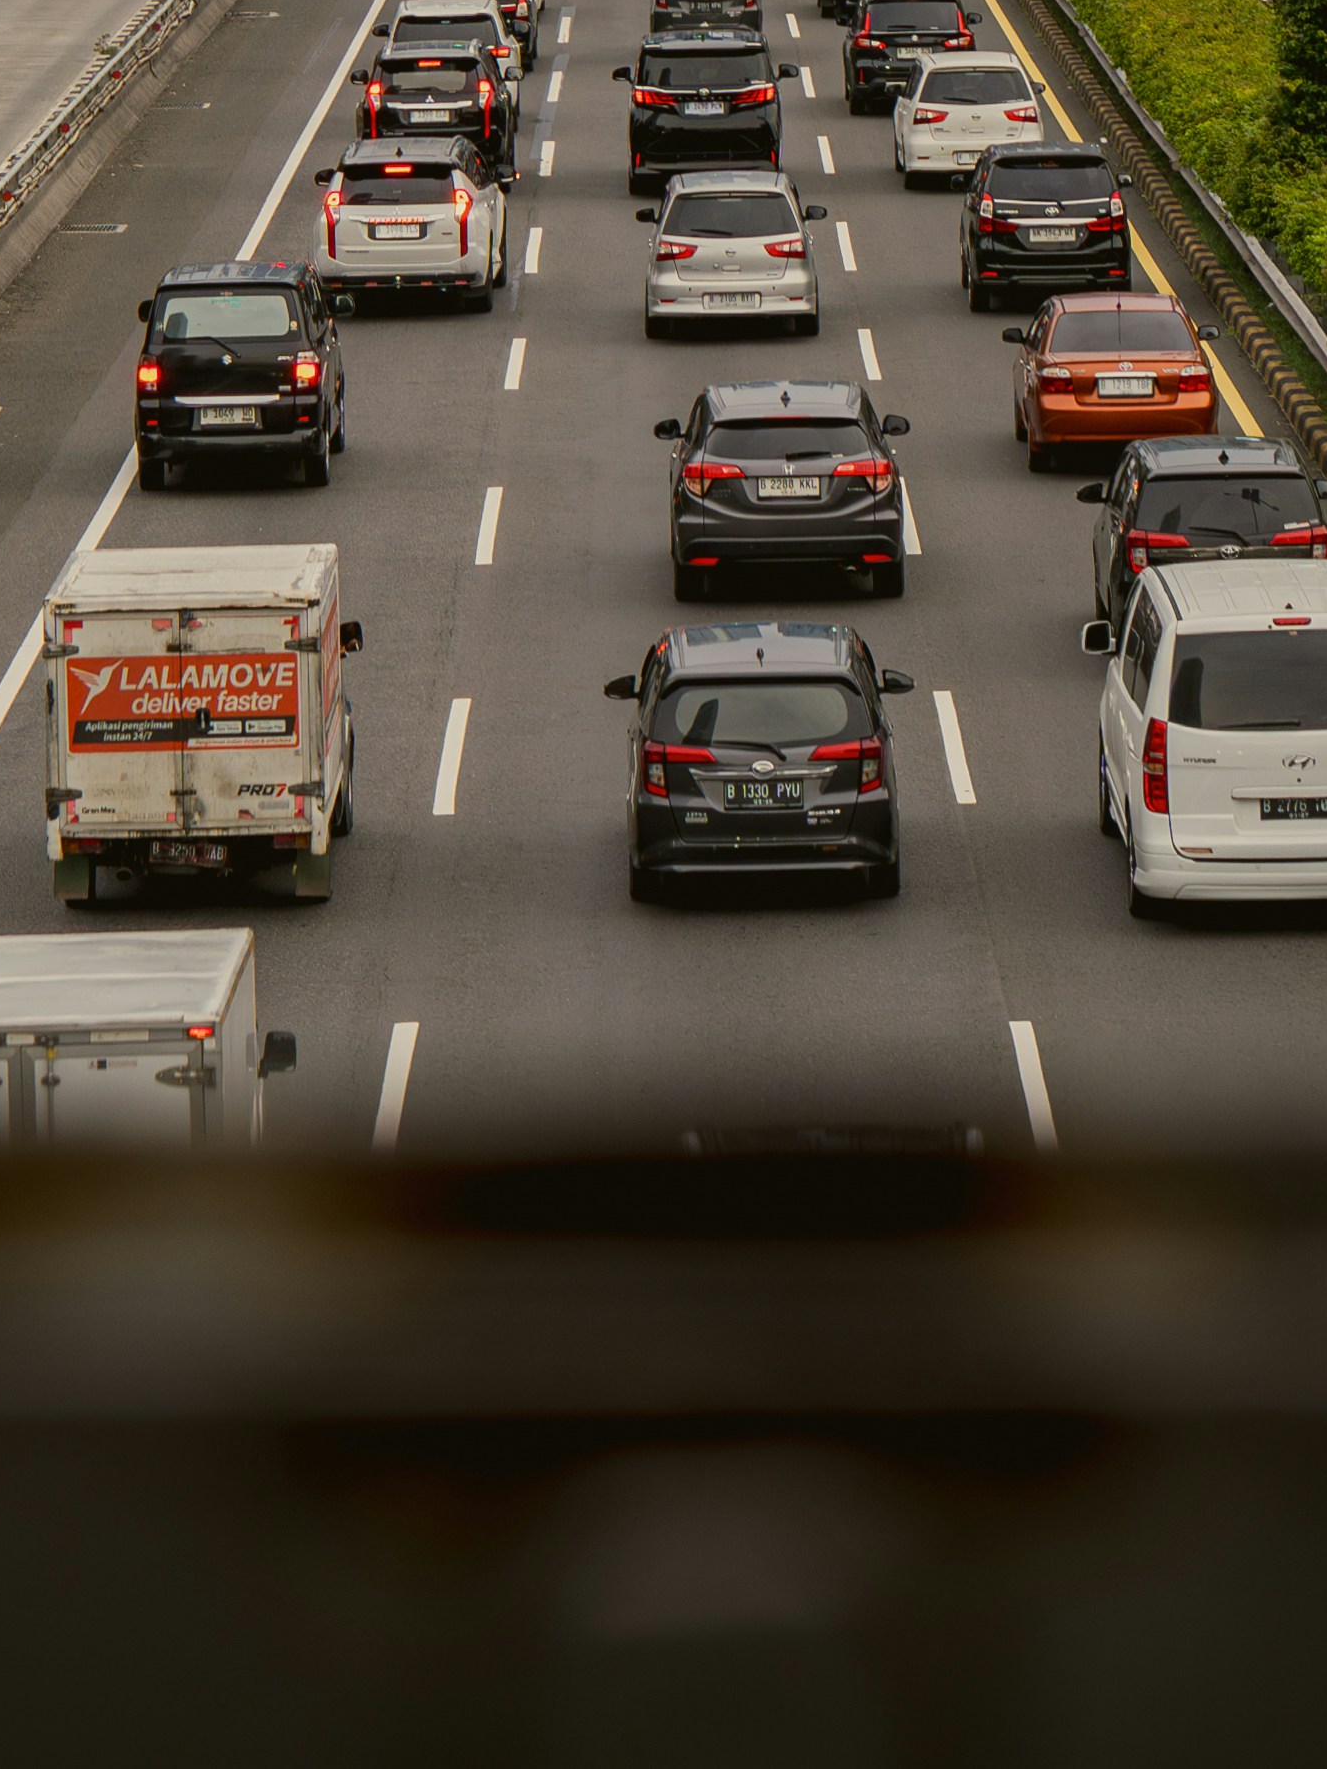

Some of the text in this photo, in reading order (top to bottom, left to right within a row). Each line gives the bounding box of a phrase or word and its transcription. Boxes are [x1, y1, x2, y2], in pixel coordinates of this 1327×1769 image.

[760, 478, 767, 490] B
[799, 478, 817, 490] KKL
[119, 662, 295, 691] LALAMOVE
[131, 689, 283, 714] deliver faster
[85, 720, 173, 732] Aplikasi pengiriman
[103, 731, 153, 742] instan 24/7
[727, 781, 800, 798] B 1330 PYU
